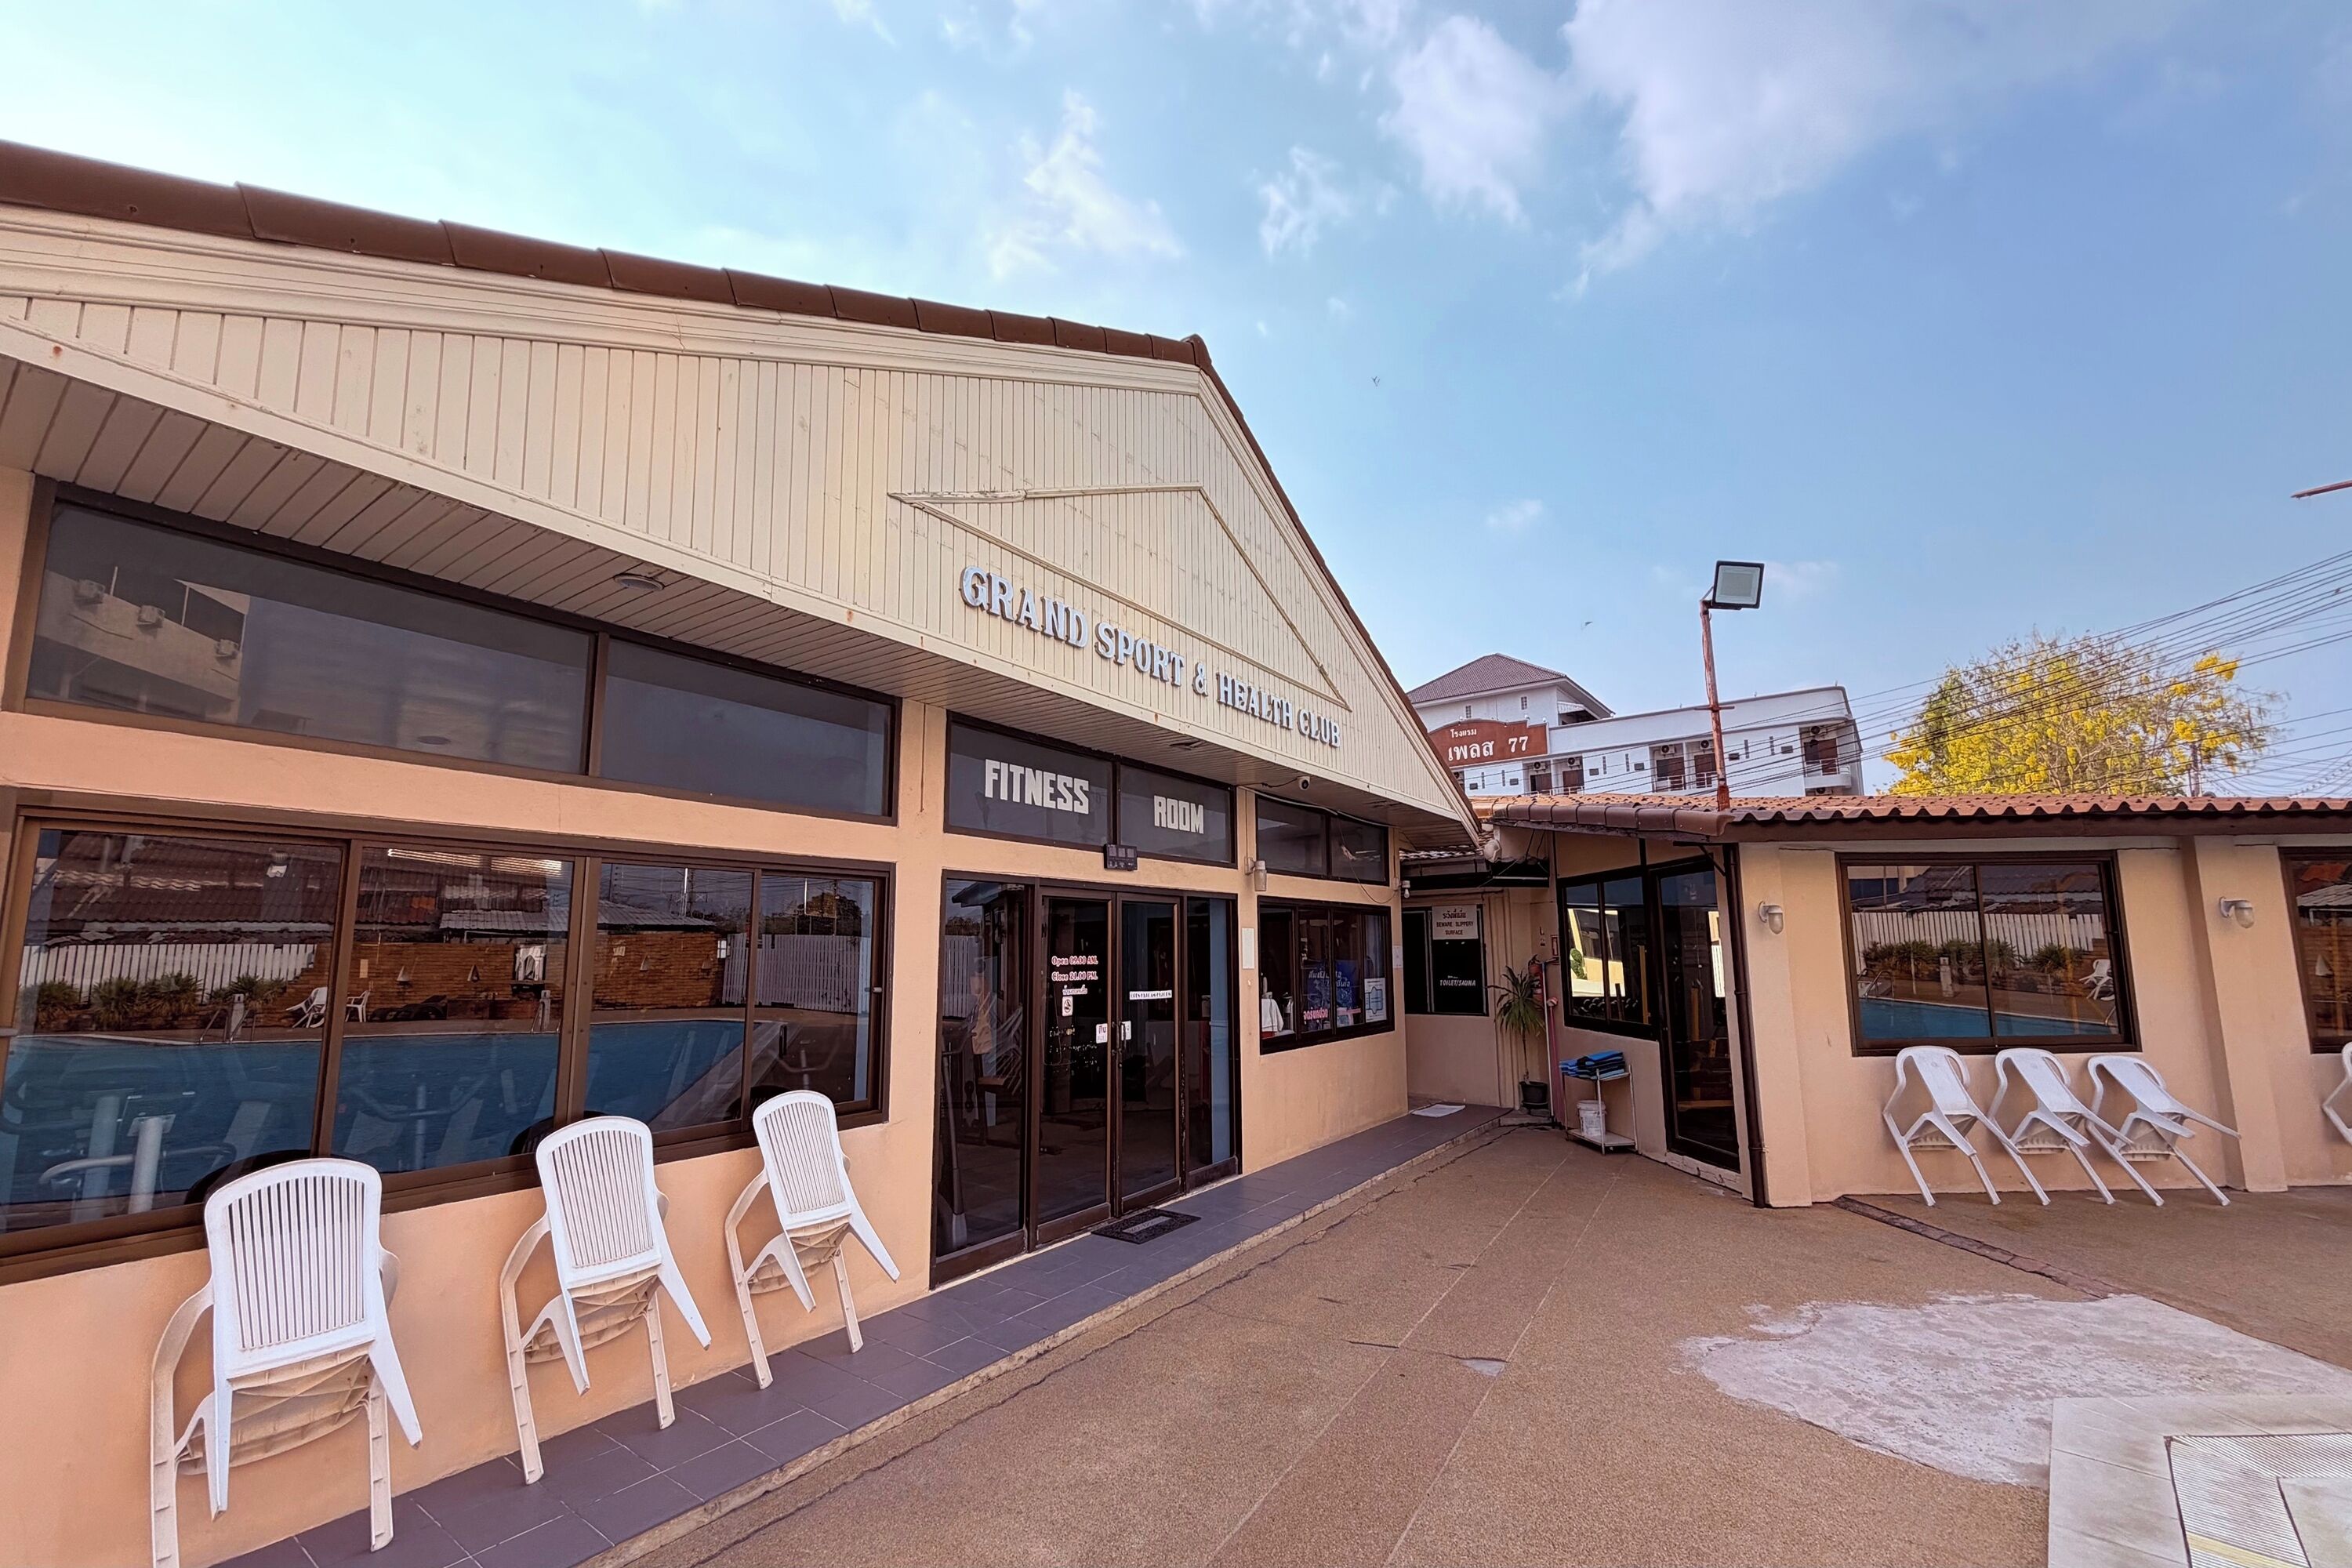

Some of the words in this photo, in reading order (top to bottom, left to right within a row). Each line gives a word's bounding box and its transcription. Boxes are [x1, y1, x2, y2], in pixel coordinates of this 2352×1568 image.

[960, 564, 1090, 649] GRAND
[1094, 621, 1185, 687] SPORT
[1192, 662, 1209, 697] &
[1216, 671, 1294, 731] HEALTH
[1296, 708, 1342, 748] CLUB
[1450, 728, 1477, 739] โรงแรม
[1448, 741, 1494, 761] เพลส
[1508, 736, 1529, 753] 77
[985, 758, 1090, 815] FITNESS
[1153, 794, 1204, 834] ROOM
[1051, 956, 1069, 967] Open
[1051, 971, 1069, 981] Close
